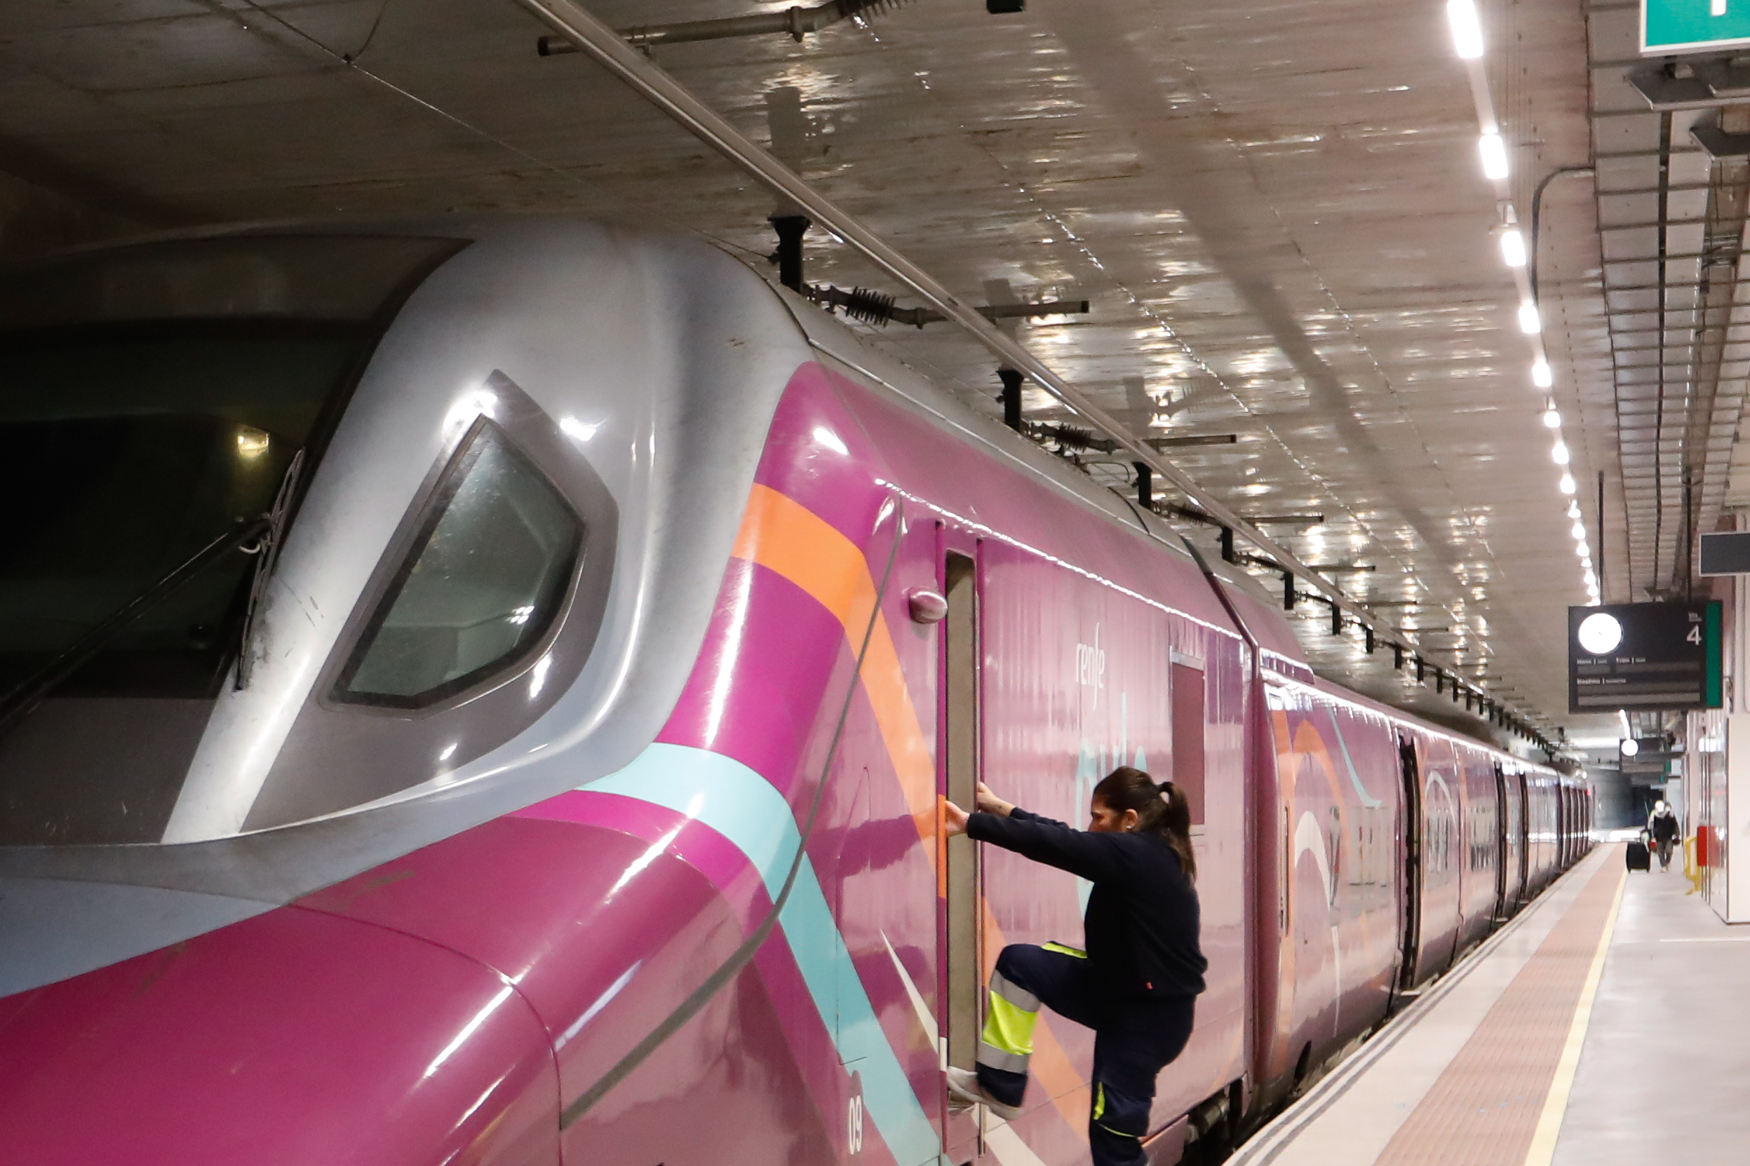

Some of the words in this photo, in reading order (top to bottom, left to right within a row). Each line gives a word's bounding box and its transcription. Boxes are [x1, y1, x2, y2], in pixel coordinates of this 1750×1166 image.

[1687, 624, 1702, 645] 4
[1076, 621, 1105, 710] renfe
[848, 1095, 863, 1155] 09
